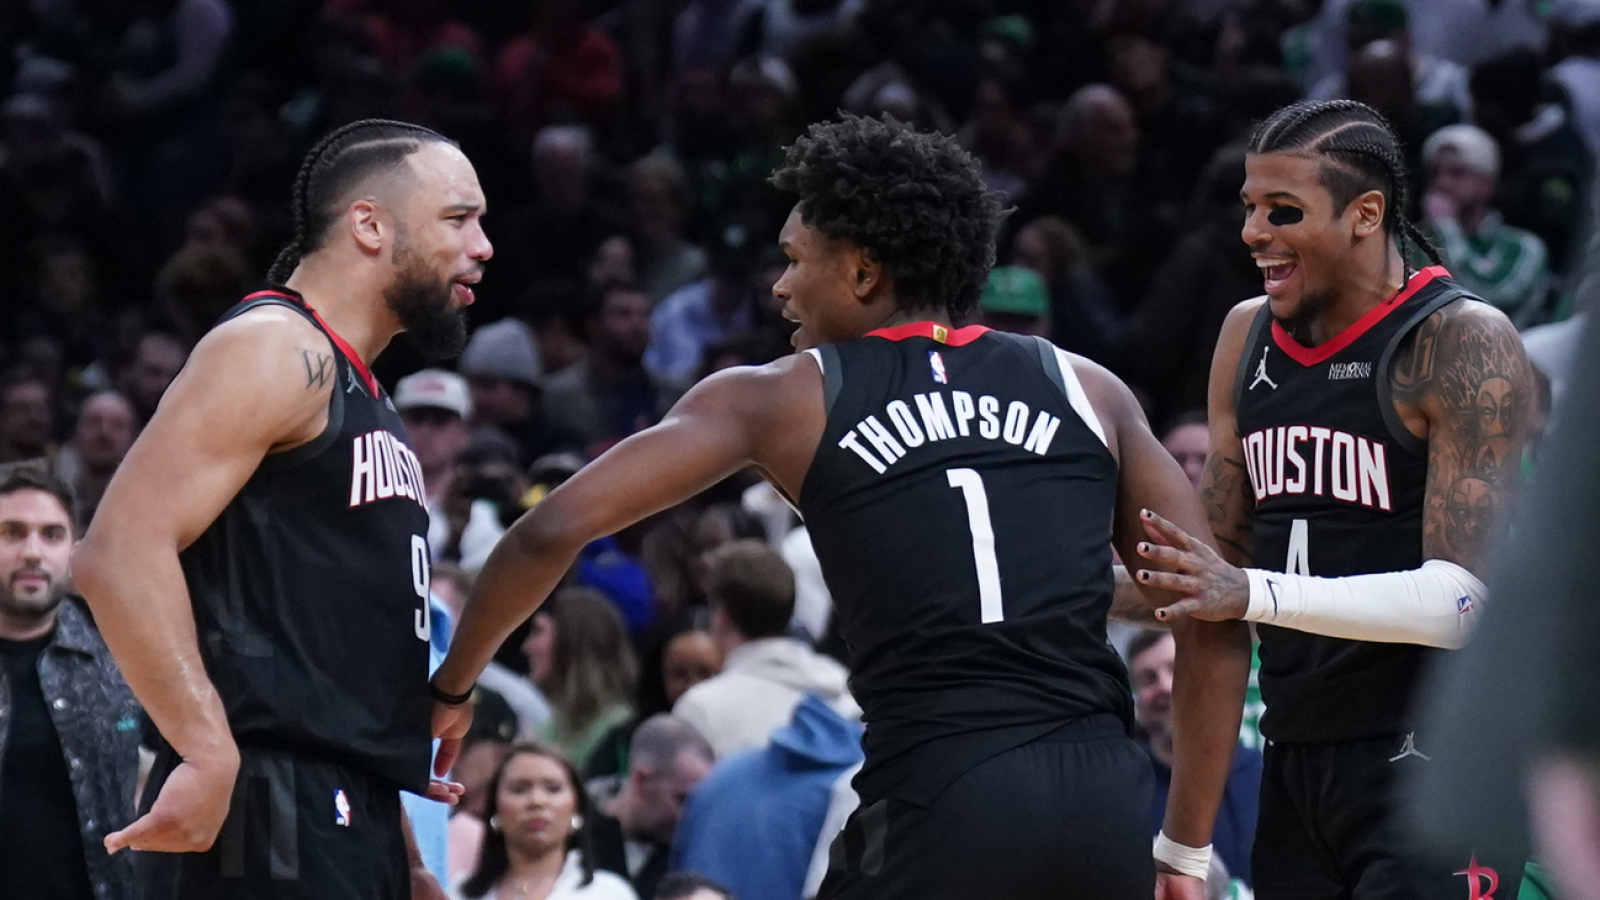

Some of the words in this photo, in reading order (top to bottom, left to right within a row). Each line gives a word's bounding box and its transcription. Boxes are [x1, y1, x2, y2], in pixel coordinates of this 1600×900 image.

[838, 390, 1061, 475] THOMPSON
[411, 534, 430, 642] 9
[946, 468, 1004, 624] 1
